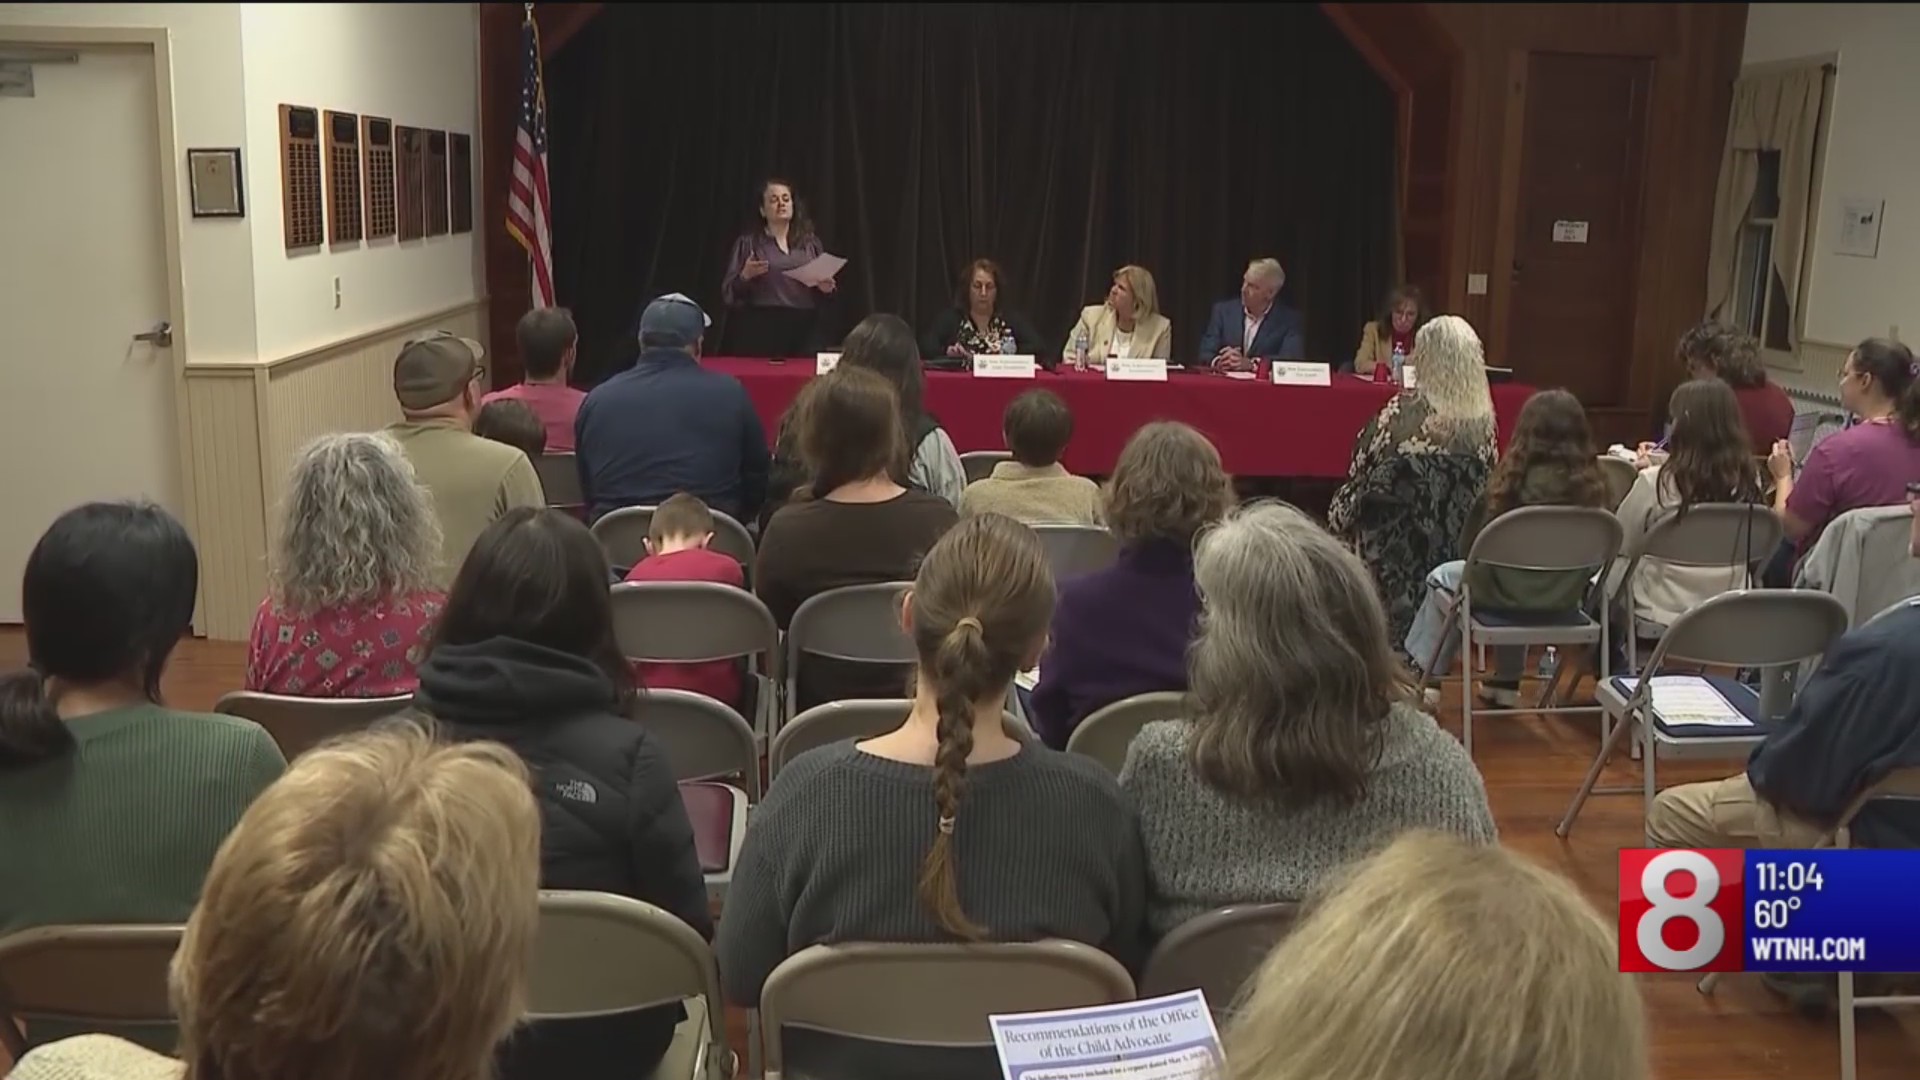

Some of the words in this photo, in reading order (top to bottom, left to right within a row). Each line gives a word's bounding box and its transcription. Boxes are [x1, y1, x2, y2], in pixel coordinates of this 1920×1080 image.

[1004, 1022, 1121, 1043] Recommendations
[1122, 1017, 1137, 1031] of
[1138, 1015, 1159, 1029] the
[1160, 1008, 1199, 1024] Office
[1039, 1044, 1053, 1058] of
[1054, 1042, 1078, 1057] the
[1077, 1038, 1112, 1055] Child
[1113, 1031, 1173, 1051] Advocate
